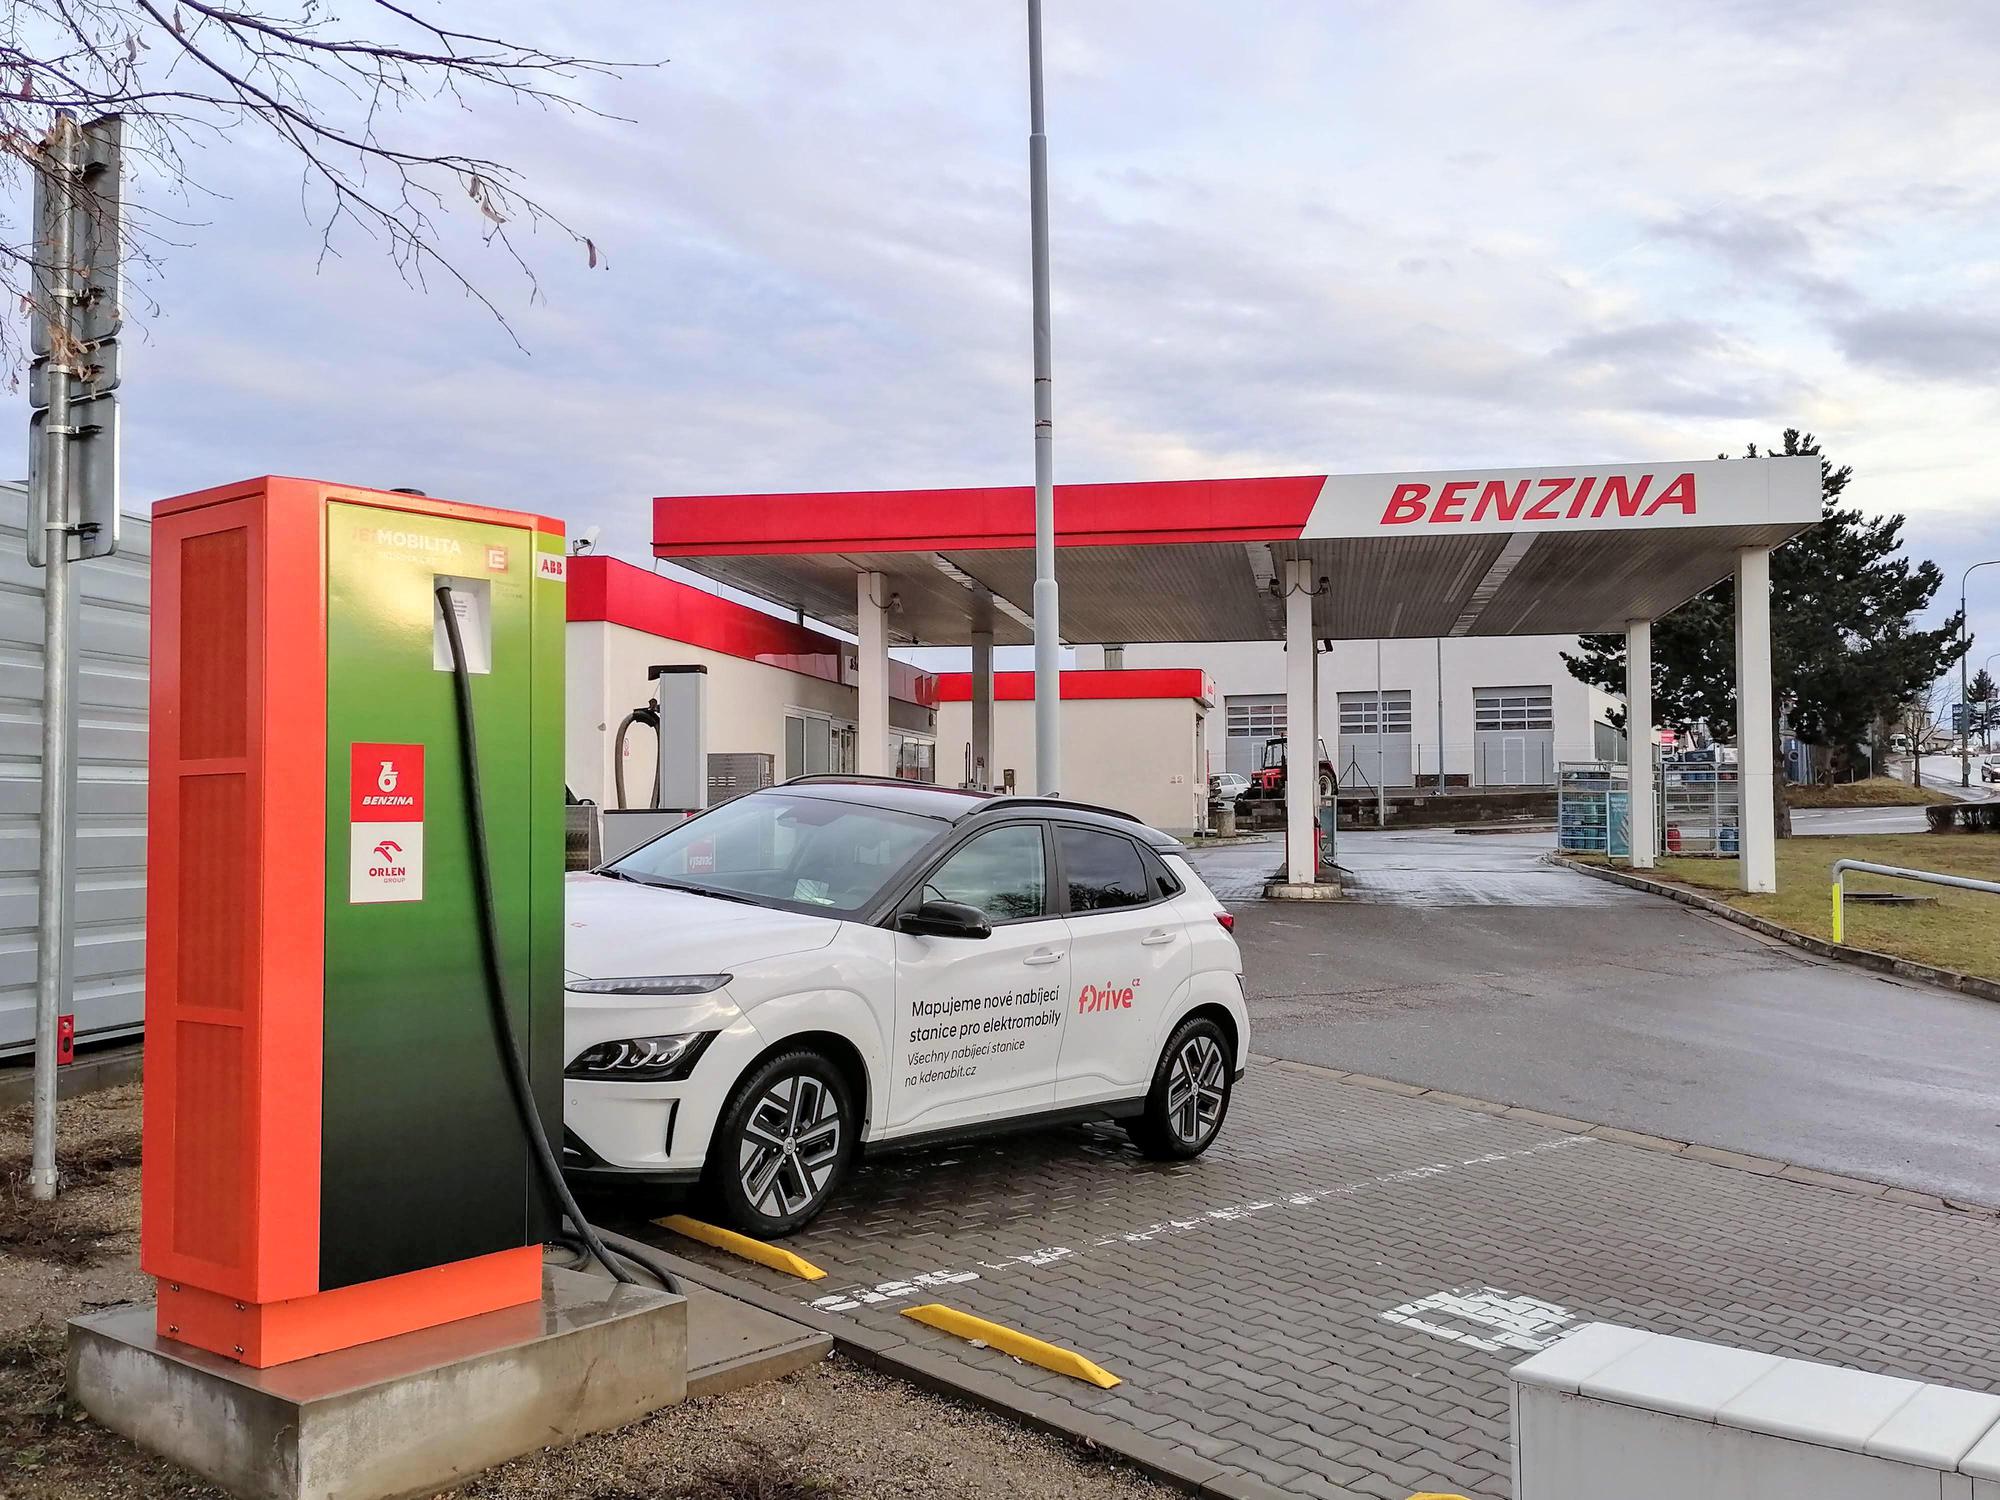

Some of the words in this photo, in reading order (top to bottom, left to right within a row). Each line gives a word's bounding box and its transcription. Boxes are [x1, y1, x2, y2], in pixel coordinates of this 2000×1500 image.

[1379, 472, 1697, 526] BENZINA
[541, 558, 563, 576] ABB
[362, 796, 414, 806] BENZINA
[368, 866, 406, 877] ORLEN
[911, 997, 982, 1019] Mapujeme
[983, 990, 1013, 1009] nové
[1015, 985, 1060, 1008] nabíjecí
[909, 1023, 957, 1043] stanice
[959, 1023, 981, 1040] pro
[983, 1010, 1062, 1034] elektromobily
[907, 1048, 950, 1066] Všechny
[950, 1042, 991, 1061] nabíjecí
[990, 1039, 1026, 1055] stanice
[904, 1075, 917, 1087] na
